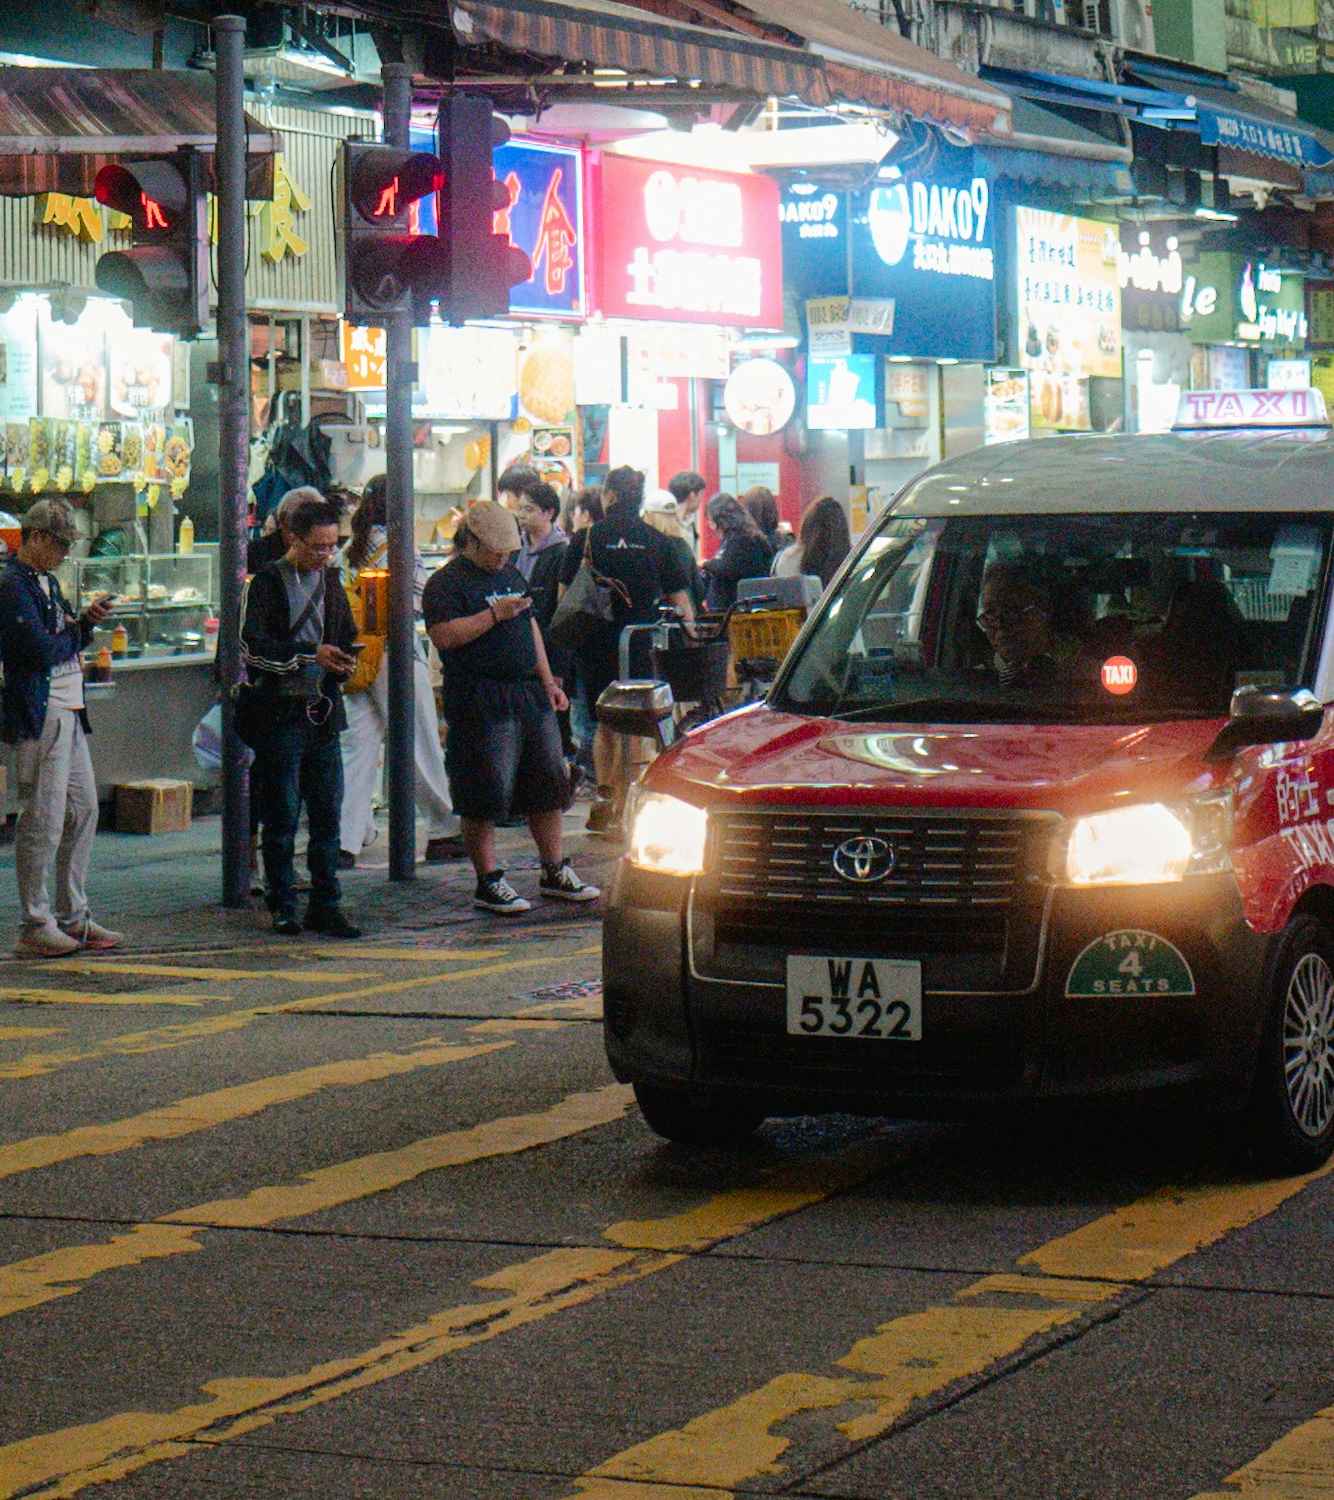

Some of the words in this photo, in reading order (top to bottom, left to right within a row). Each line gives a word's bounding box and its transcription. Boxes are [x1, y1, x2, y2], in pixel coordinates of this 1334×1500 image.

[1186, 391, 1308, 421] TAXI
[1103, 664, 1134, 686] TAXI
[1105, 933, 1156, 951] TAXI
[1118, 950, 1144, 978] 4
[827, 958, 881, 999] WA
[1093, 978, 1169, 993] SEATS
[798, 1000, 912, 1041] 5322
